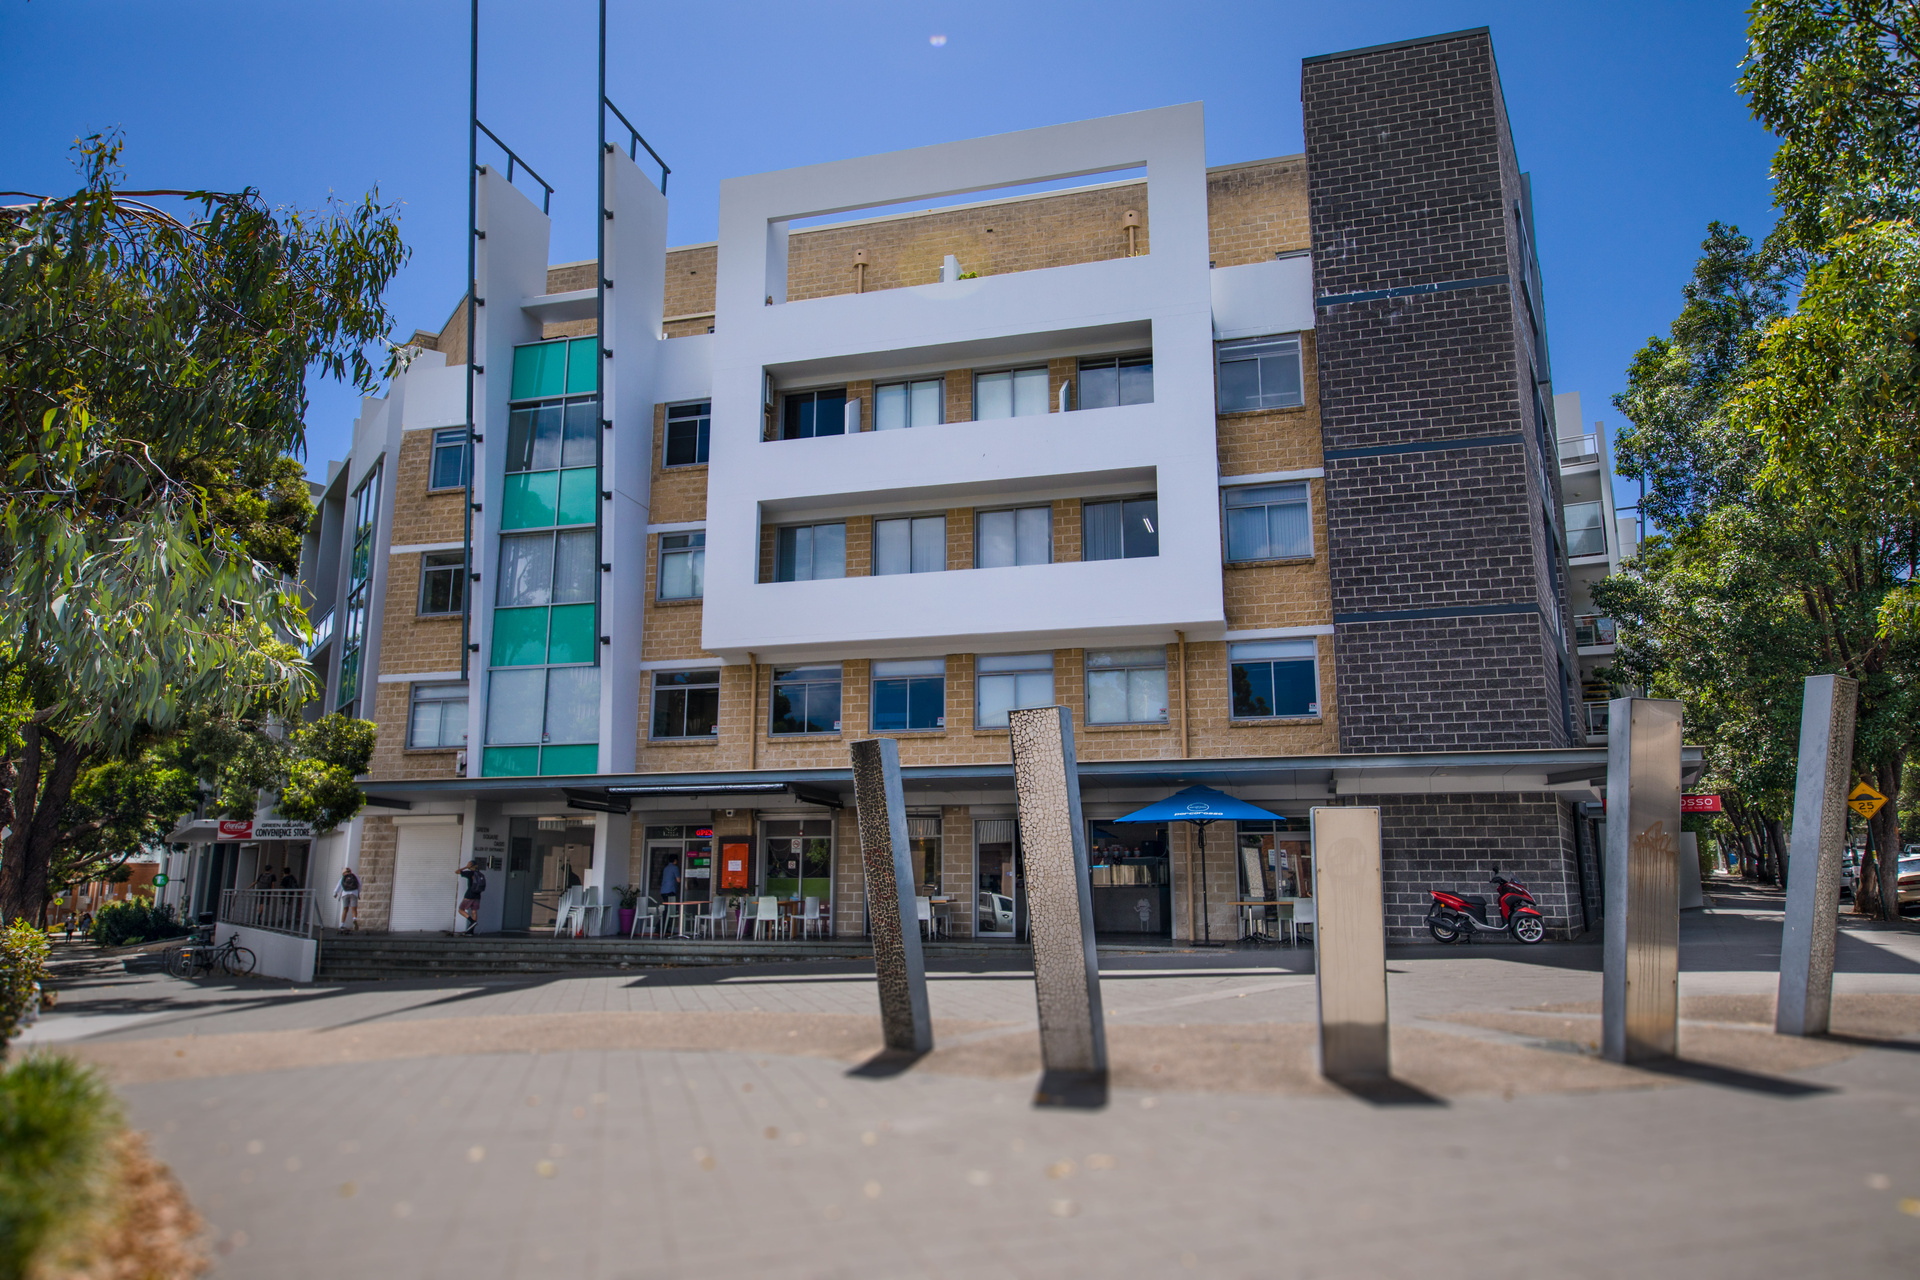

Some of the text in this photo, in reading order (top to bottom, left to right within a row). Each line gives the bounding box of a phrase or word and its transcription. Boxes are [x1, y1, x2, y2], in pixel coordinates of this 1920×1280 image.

[1858, 802, 1874, 810] 25
[255, 828, 311, 837] CONVENIENCE STORE
